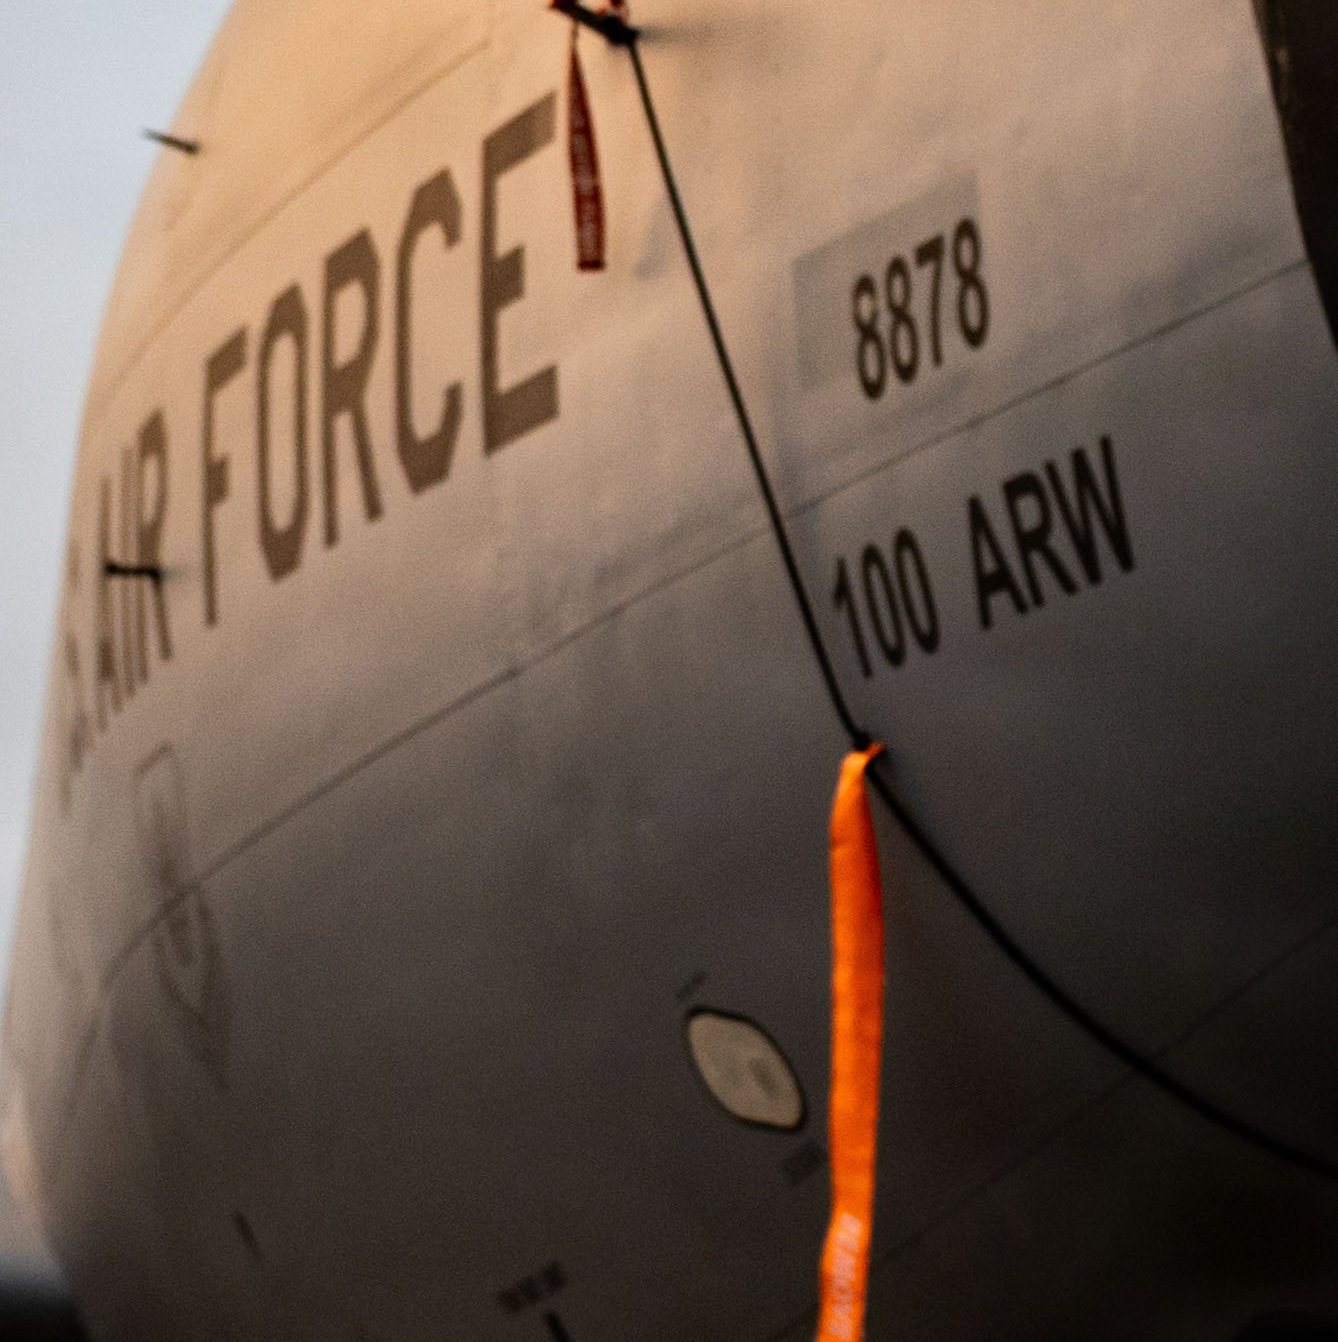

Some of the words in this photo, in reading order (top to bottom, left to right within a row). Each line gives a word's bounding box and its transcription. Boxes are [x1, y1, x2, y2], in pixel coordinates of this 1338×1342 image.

[201, 90, 561, 630] FORCE
[851, 217, 990, 401] 8878
[833, 527, 941, 679] 100
[968, 435, 1136, 631] ARW
